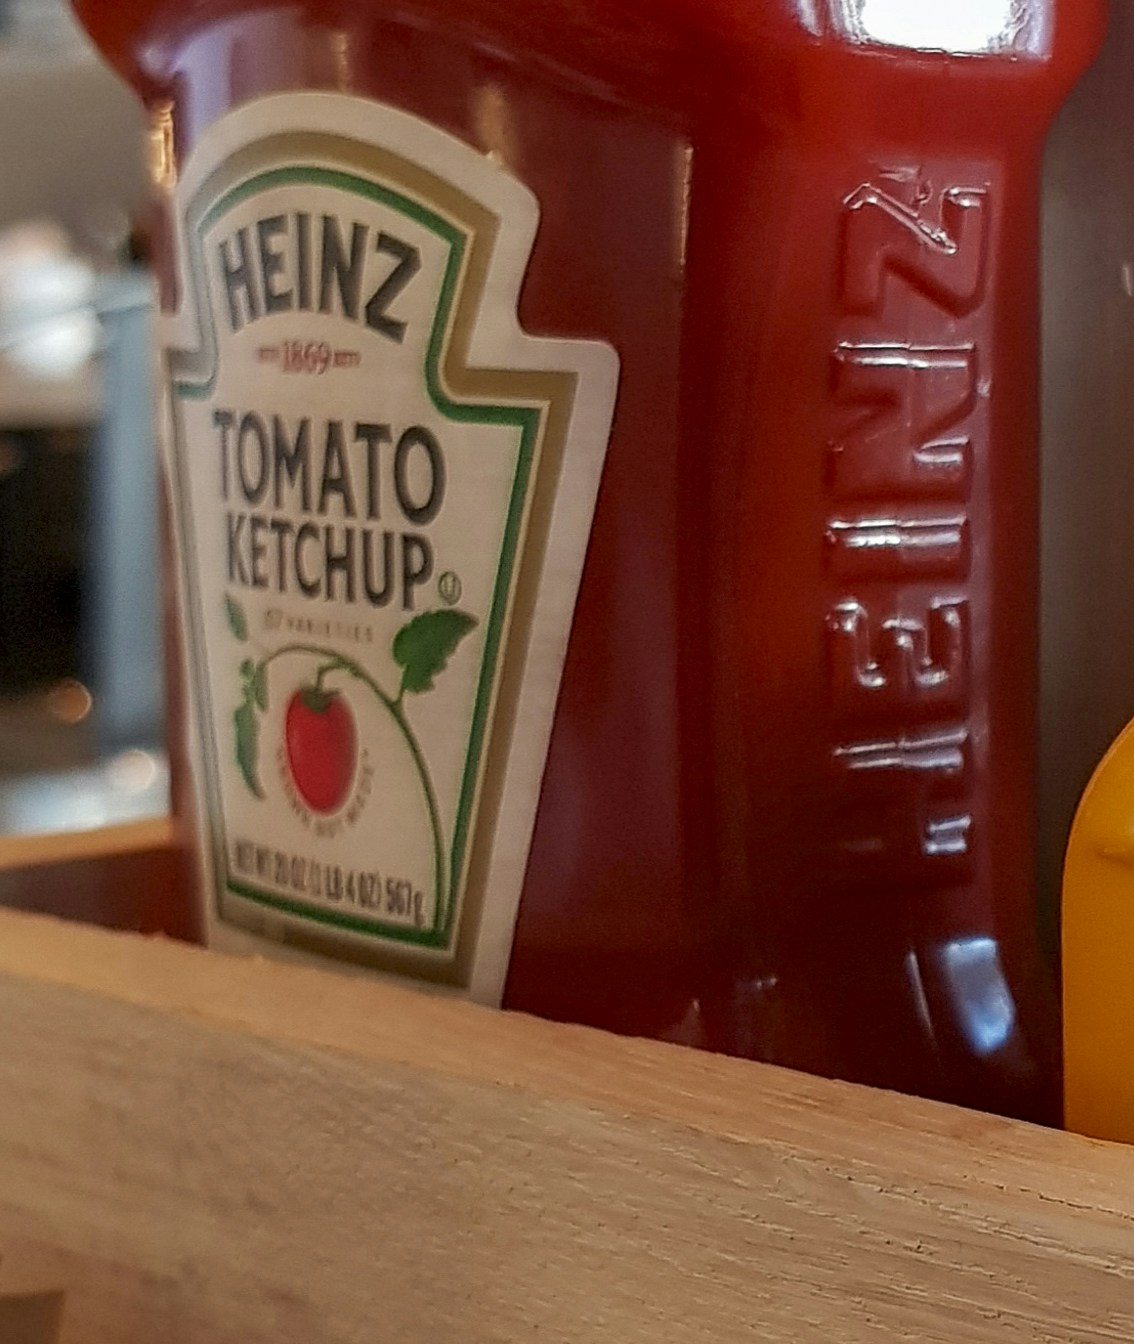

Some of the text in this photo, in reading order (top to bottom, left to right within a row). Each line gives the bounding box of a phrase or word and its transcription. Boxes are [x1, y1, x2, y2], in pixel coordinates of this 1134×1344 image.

[218, 212, 422, 345] HEINZ
[212, 408, 447, 527] TOMATO
[827, 177, 990, 859] HEINZ
[224, 512, 434, 611] KETCHUP
